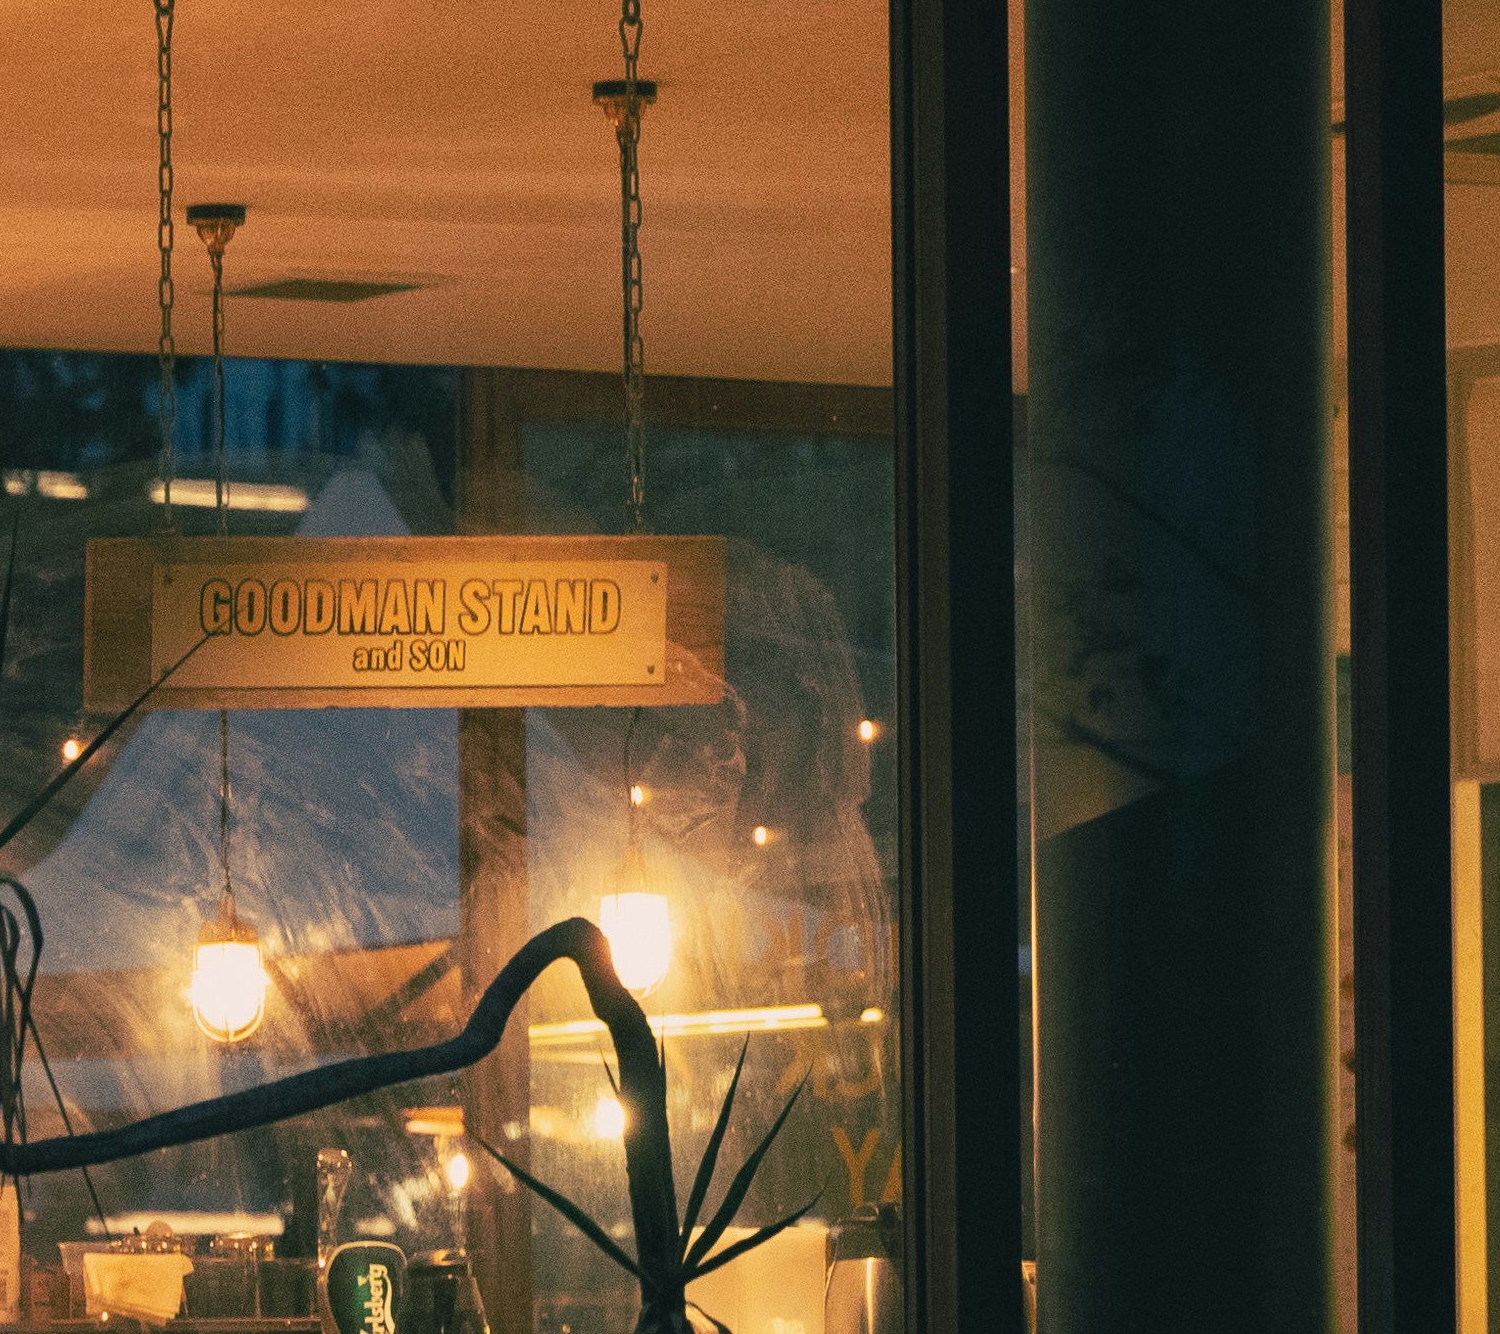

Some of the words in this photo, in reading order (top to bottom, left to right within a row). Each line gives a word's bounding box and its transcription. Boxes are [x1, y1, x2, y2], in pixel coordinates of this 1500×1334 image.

[200, 578, 446, 636] GOODMAN
[460, 578, 621, 636] STAND
[352, 640, 402, 672] and
[409, 640, 467, 672] SON
